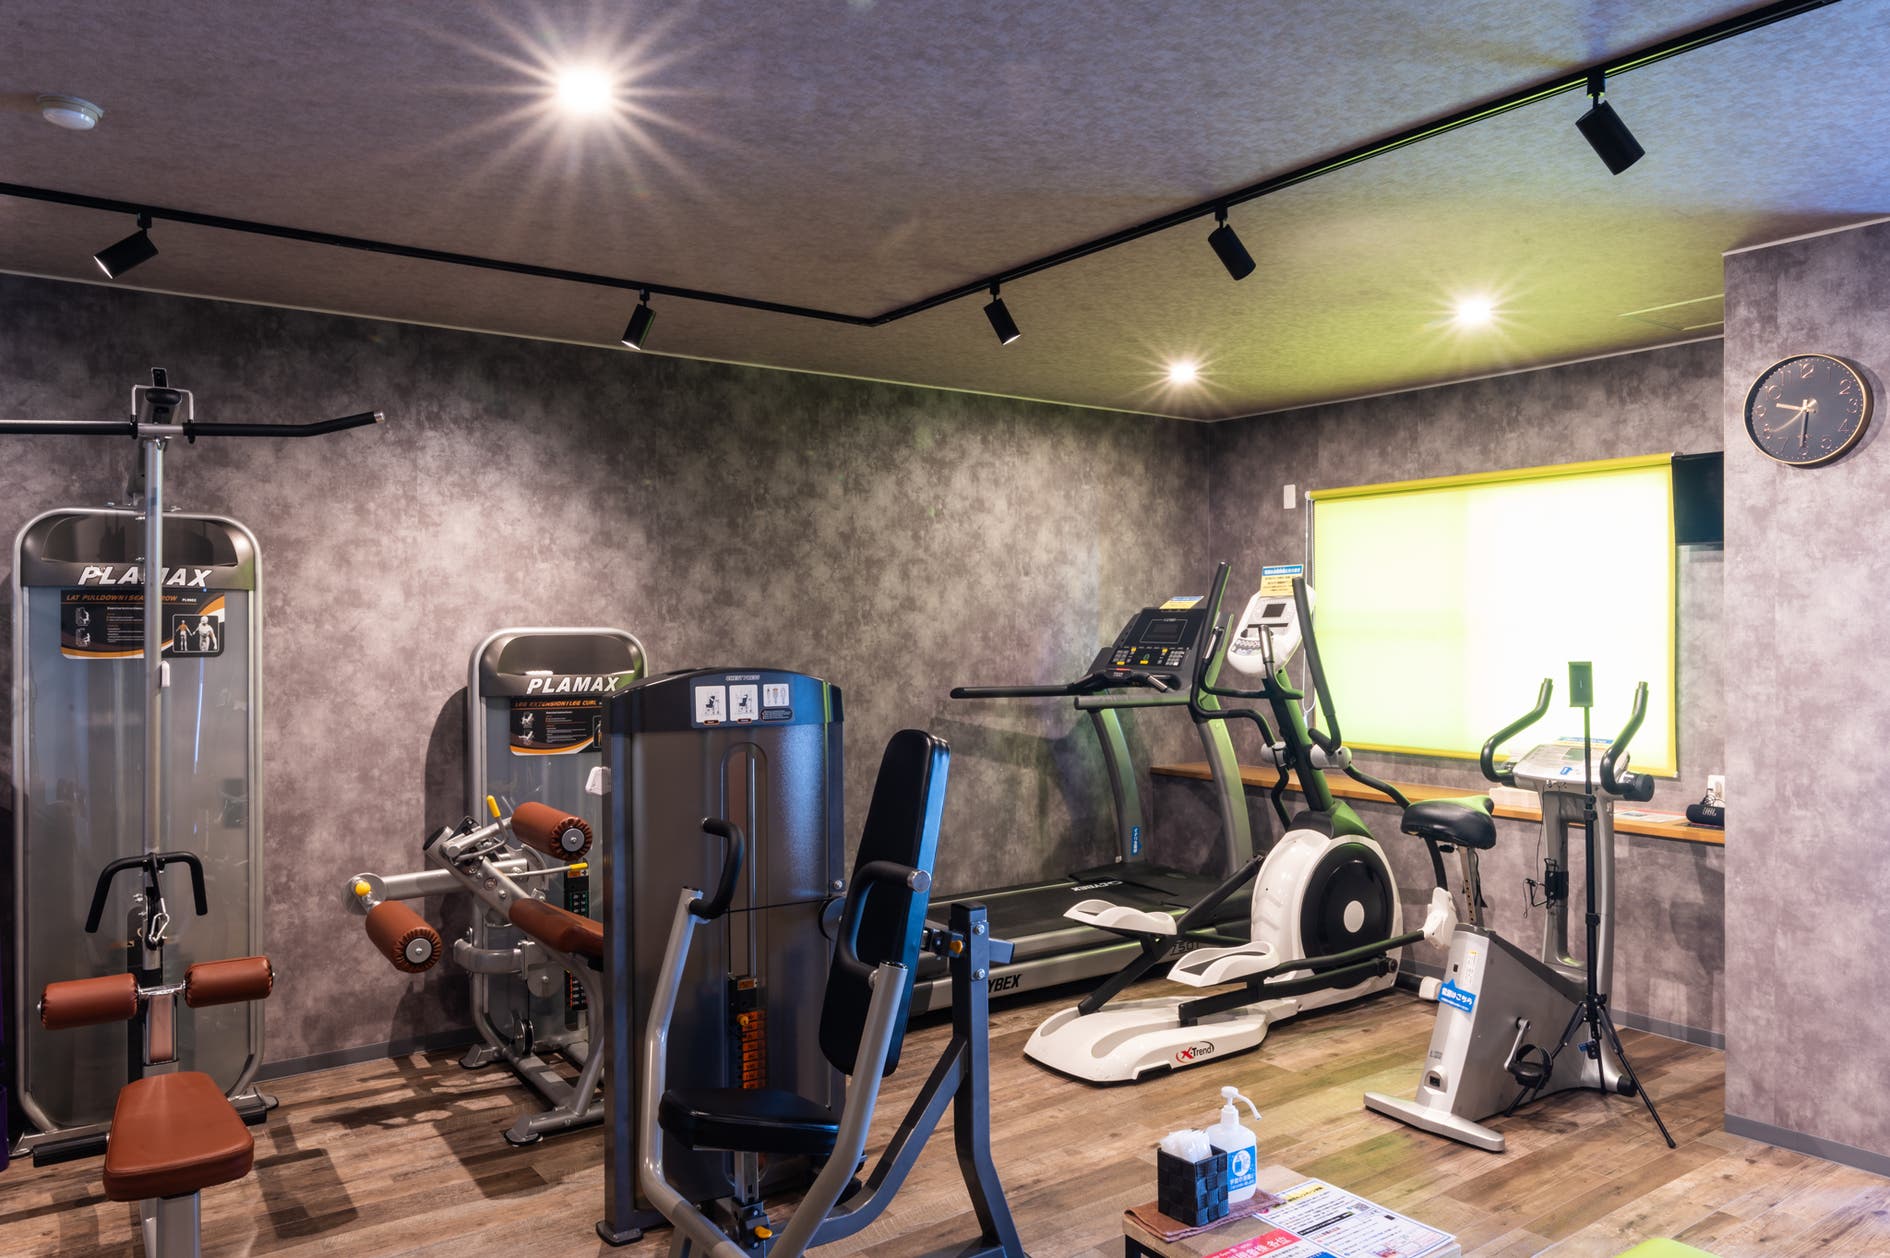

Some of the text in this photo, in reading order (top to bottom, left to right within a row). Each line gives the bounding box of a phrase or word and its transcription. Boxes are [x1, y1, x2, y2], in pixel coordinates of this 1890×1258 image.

[1779, 370, 1793, 386] 11
[1799, 363, 1815, 378] 12
[1764, 385, 1783, 400] 10
[1839, 378, 1851, 395] 2
[1755, 404, 1767, 420] 9
[1846, 398, 1858, 414] 3
[1763, 423, 1772, 440] 8
[1838, 418, 1850, 432] 4
[1778, 436, 1789, 453] 7
[78, 566, 212, 587] PLAAX
[526, 676, 620, 694] PLAMAX
[988, 973, 1022, 993] YBEX
